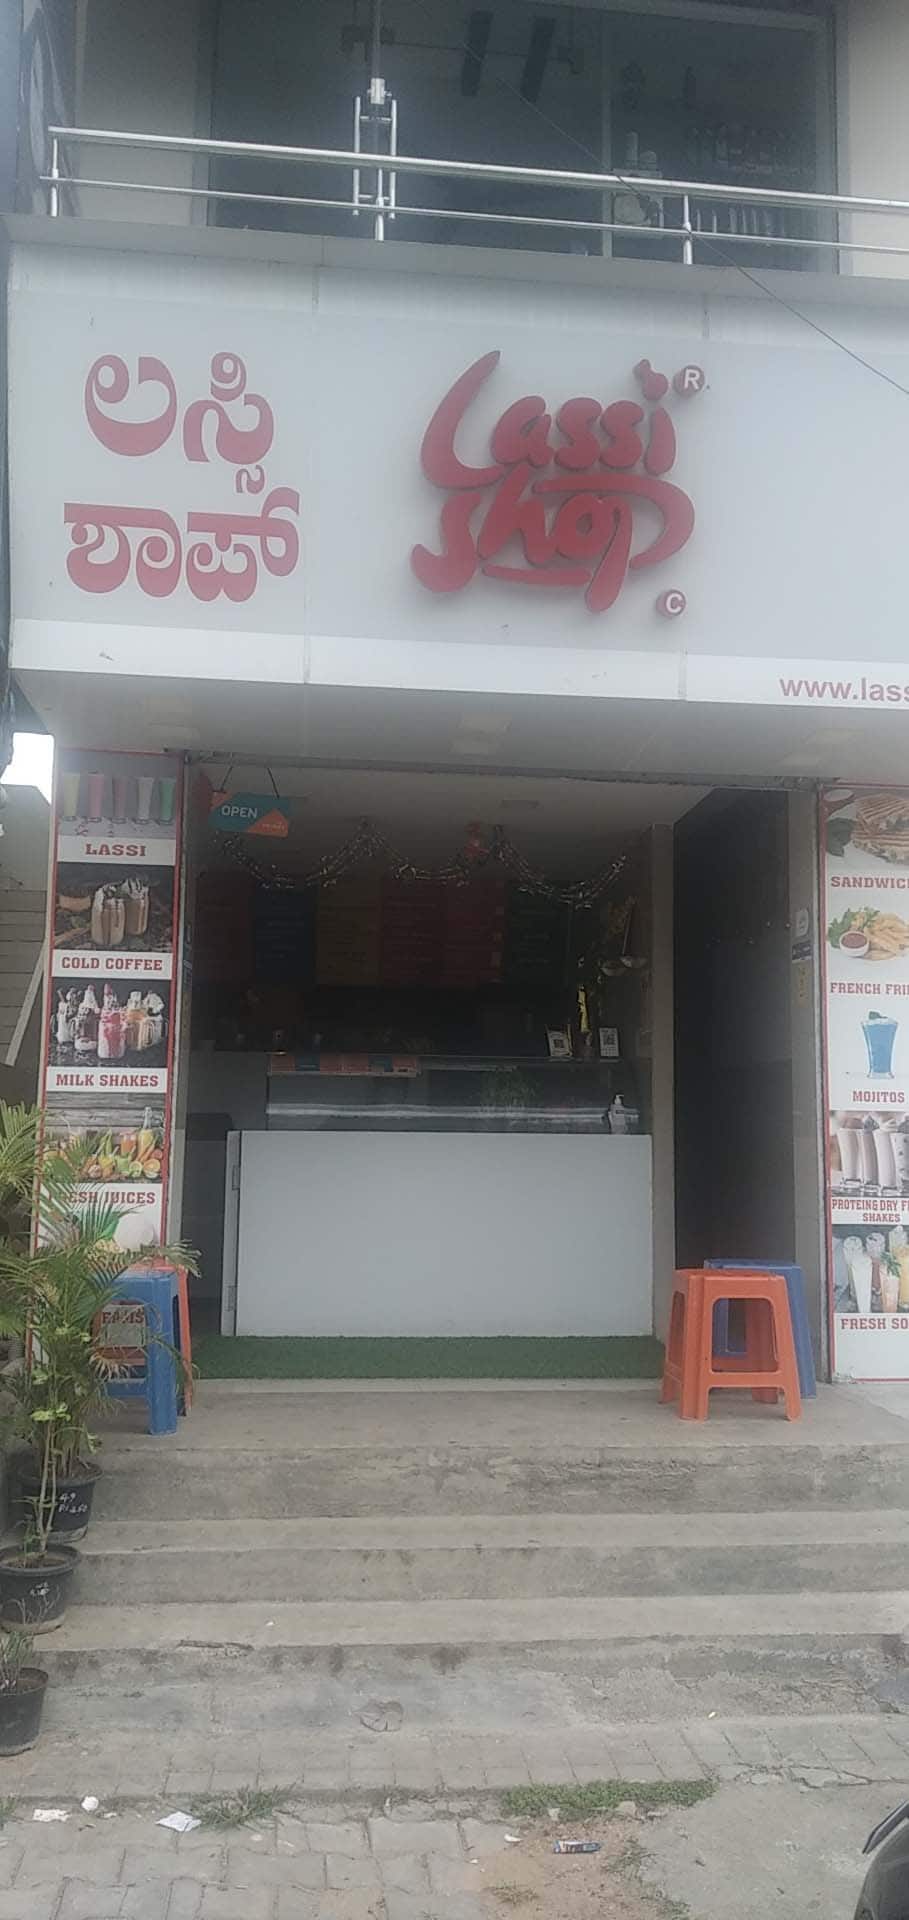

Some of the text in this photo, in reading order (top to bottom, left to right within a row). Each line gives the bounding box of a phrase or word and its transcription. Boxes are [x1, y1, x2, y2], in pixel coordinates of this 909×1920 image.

[84, 351, 274, 495] ಲಸ್ಸಿ
[420, 350, 676, 490] Lassi
[63, 486, 300, 603] ಶಾಪ್
[221, 805, 258, 819] OPEN
[85, 843, 147, 857] LASSI
[831, 876, 909, 889] SANDWIC
[61, 957, 163, 971] COLD COFFEE
[831, 982, 881, 995] FRENCH
[56, 1074, 159, 1087] MILK SHAKES
[852, 1090, 905, 1103] MOJITOS
[104, 1191, 156, 1205] JUICES
[901, 1200, 909, 1211] F
[862, 1212, 901, 1223] SHAKES
[841, 1317, 886, 1330] FRESH
